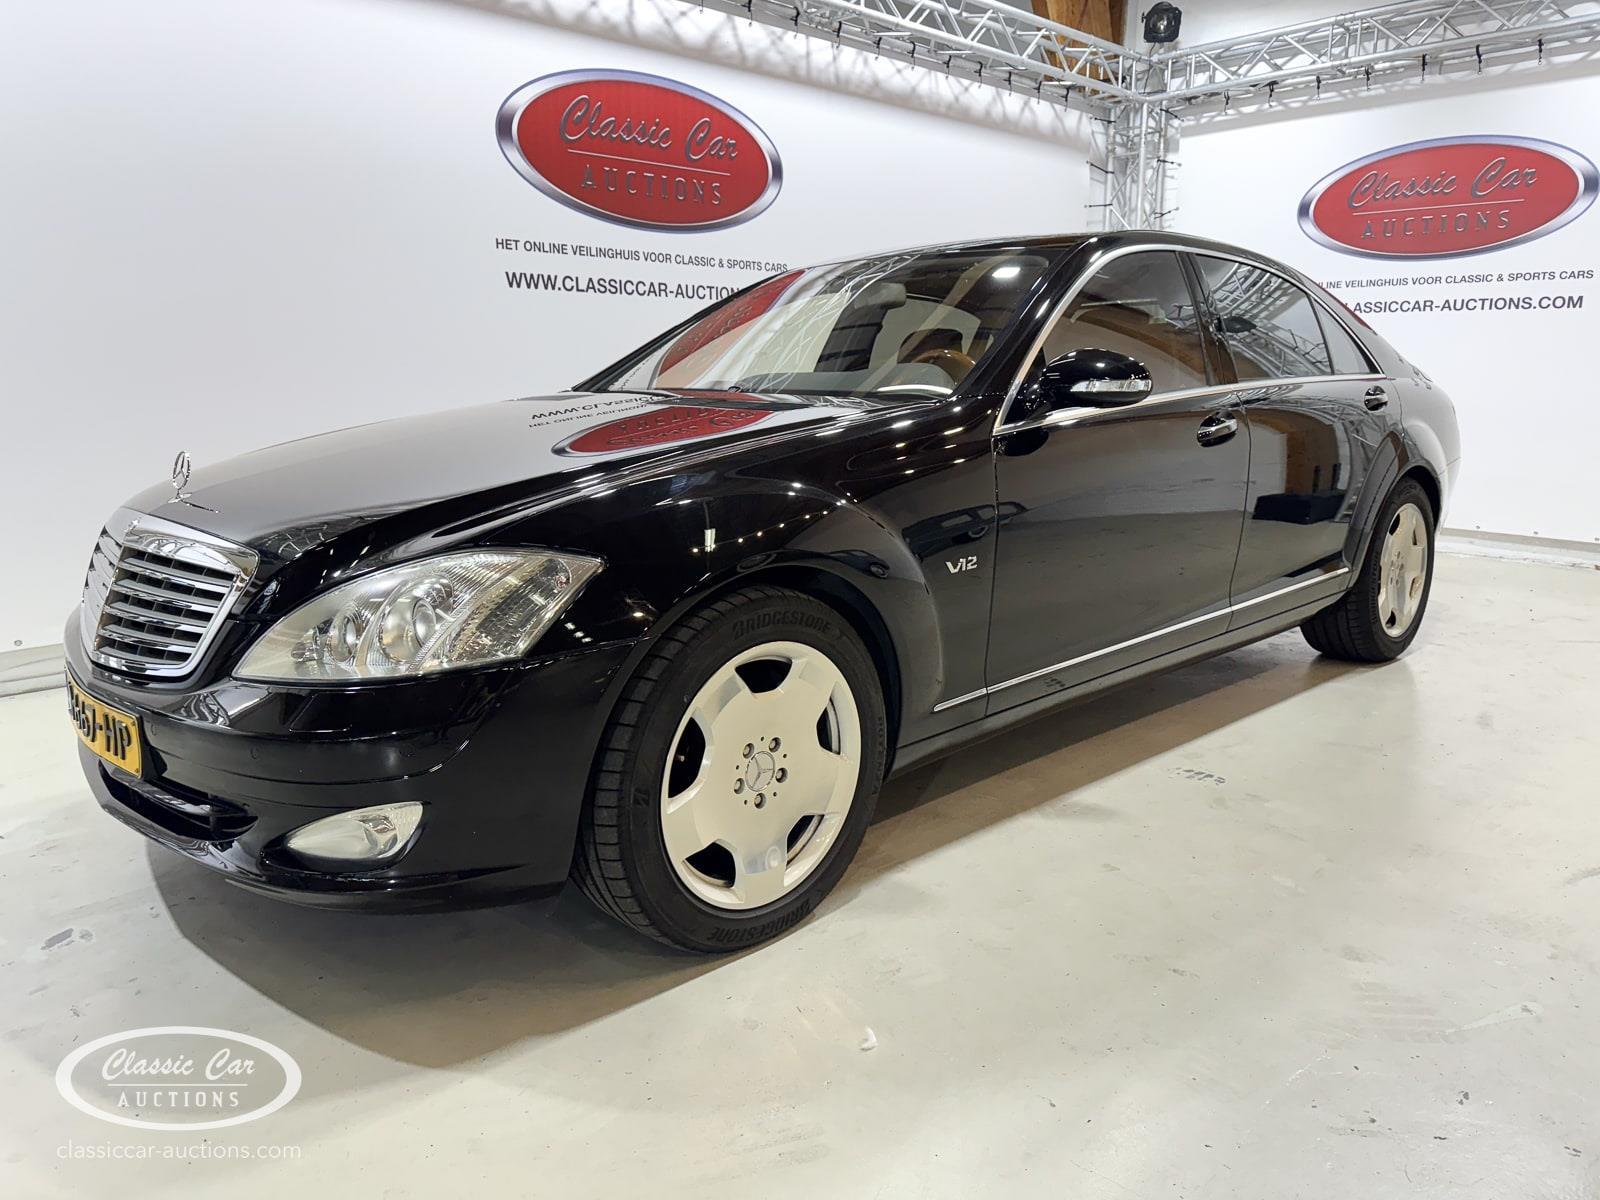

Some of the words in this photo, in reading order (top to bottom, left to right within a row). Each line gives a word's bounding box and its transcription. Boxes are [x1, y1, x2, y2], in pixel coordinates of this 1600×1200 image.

[559, 95, 672, 149] Classic
[685, 117, 738, 161] Car
[581, 164, 721, 205] AUCTIONS
[1348, 170, 1457, 208] Classic
[1471, 157, 1538, 198] Car
[1361, 210, 1511, 239] AUCTIONS
[495, 237, 520, 251] HET
[523, 240, 568, 255] ONLINE
[571, 244, 641, 262] VEILINGHUIS
[642, 251, 672, 264] VOOR
[674, 253, 716, 268] CLASSIC
[717, 257, 725, 268] &
[726, 258, 762, 272] SPORTS
[764, 262, 788, 273] CARS
[1319, 280, 1342, 289] LINE
[1345, 276, 1409, 288] VEILINGHUIS
[1411, 275, 1442, 285] VOOR
[1445, 273, 1495, 284] CLASSIC
[1496, 273, 1504, 282] &
[1507, 271, 1556, 282] SPORTS
[1559, 269, 1594, 280] CARS
[1345, 295, 1584, 314] ASSICCAR-AUCTIONS.COM
[945, 556, 978, 574] V12
[731, 611, 832, 641] BRIDGESTONE
[707, 899, 811, 943] BRIDGESTONE
